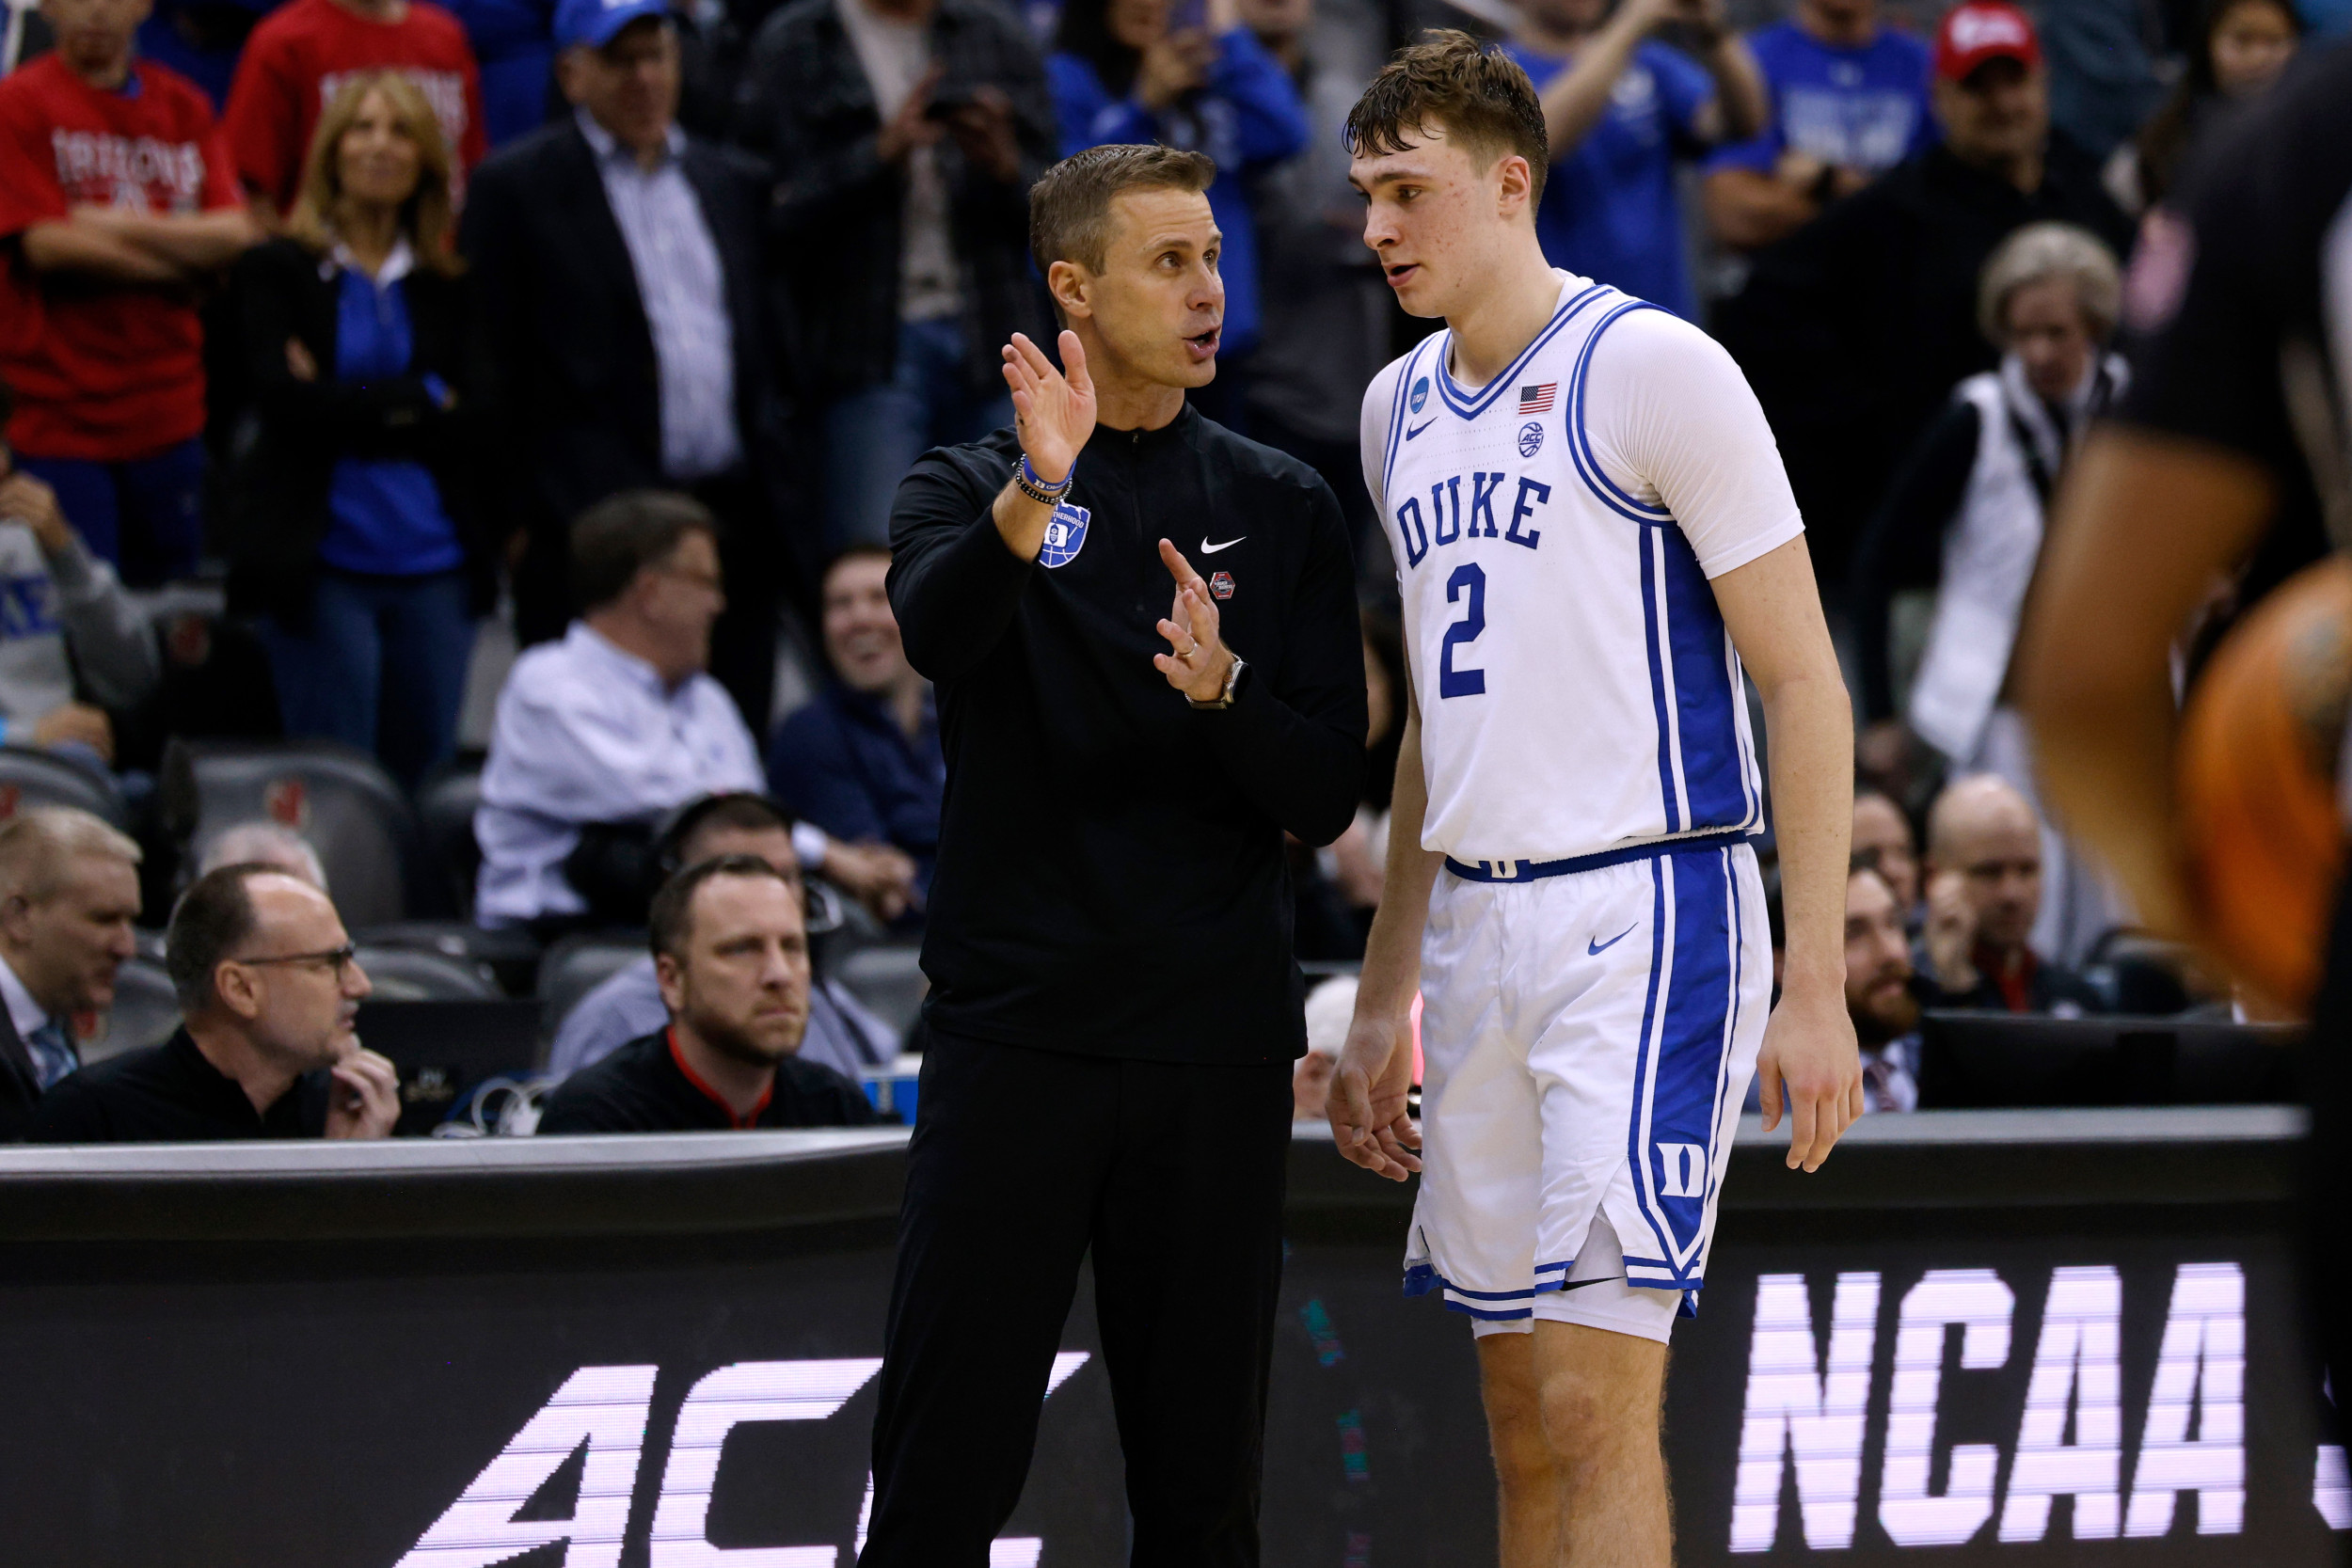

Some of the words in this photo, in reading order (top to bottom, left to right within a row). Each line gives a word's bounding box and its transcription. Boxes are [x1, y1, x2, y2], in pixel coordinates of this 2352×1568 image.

[1521, 432, 1542, 443] ACC
[1053, 511, 1085, 529] THERHOOD
[1397, 472, 1551, 569] DUKE
[1440, 562, 1486, 699] 2
[1656, 1143, 1706, 1198] D
[1729, 1262, 2246, 1553] NCAA
